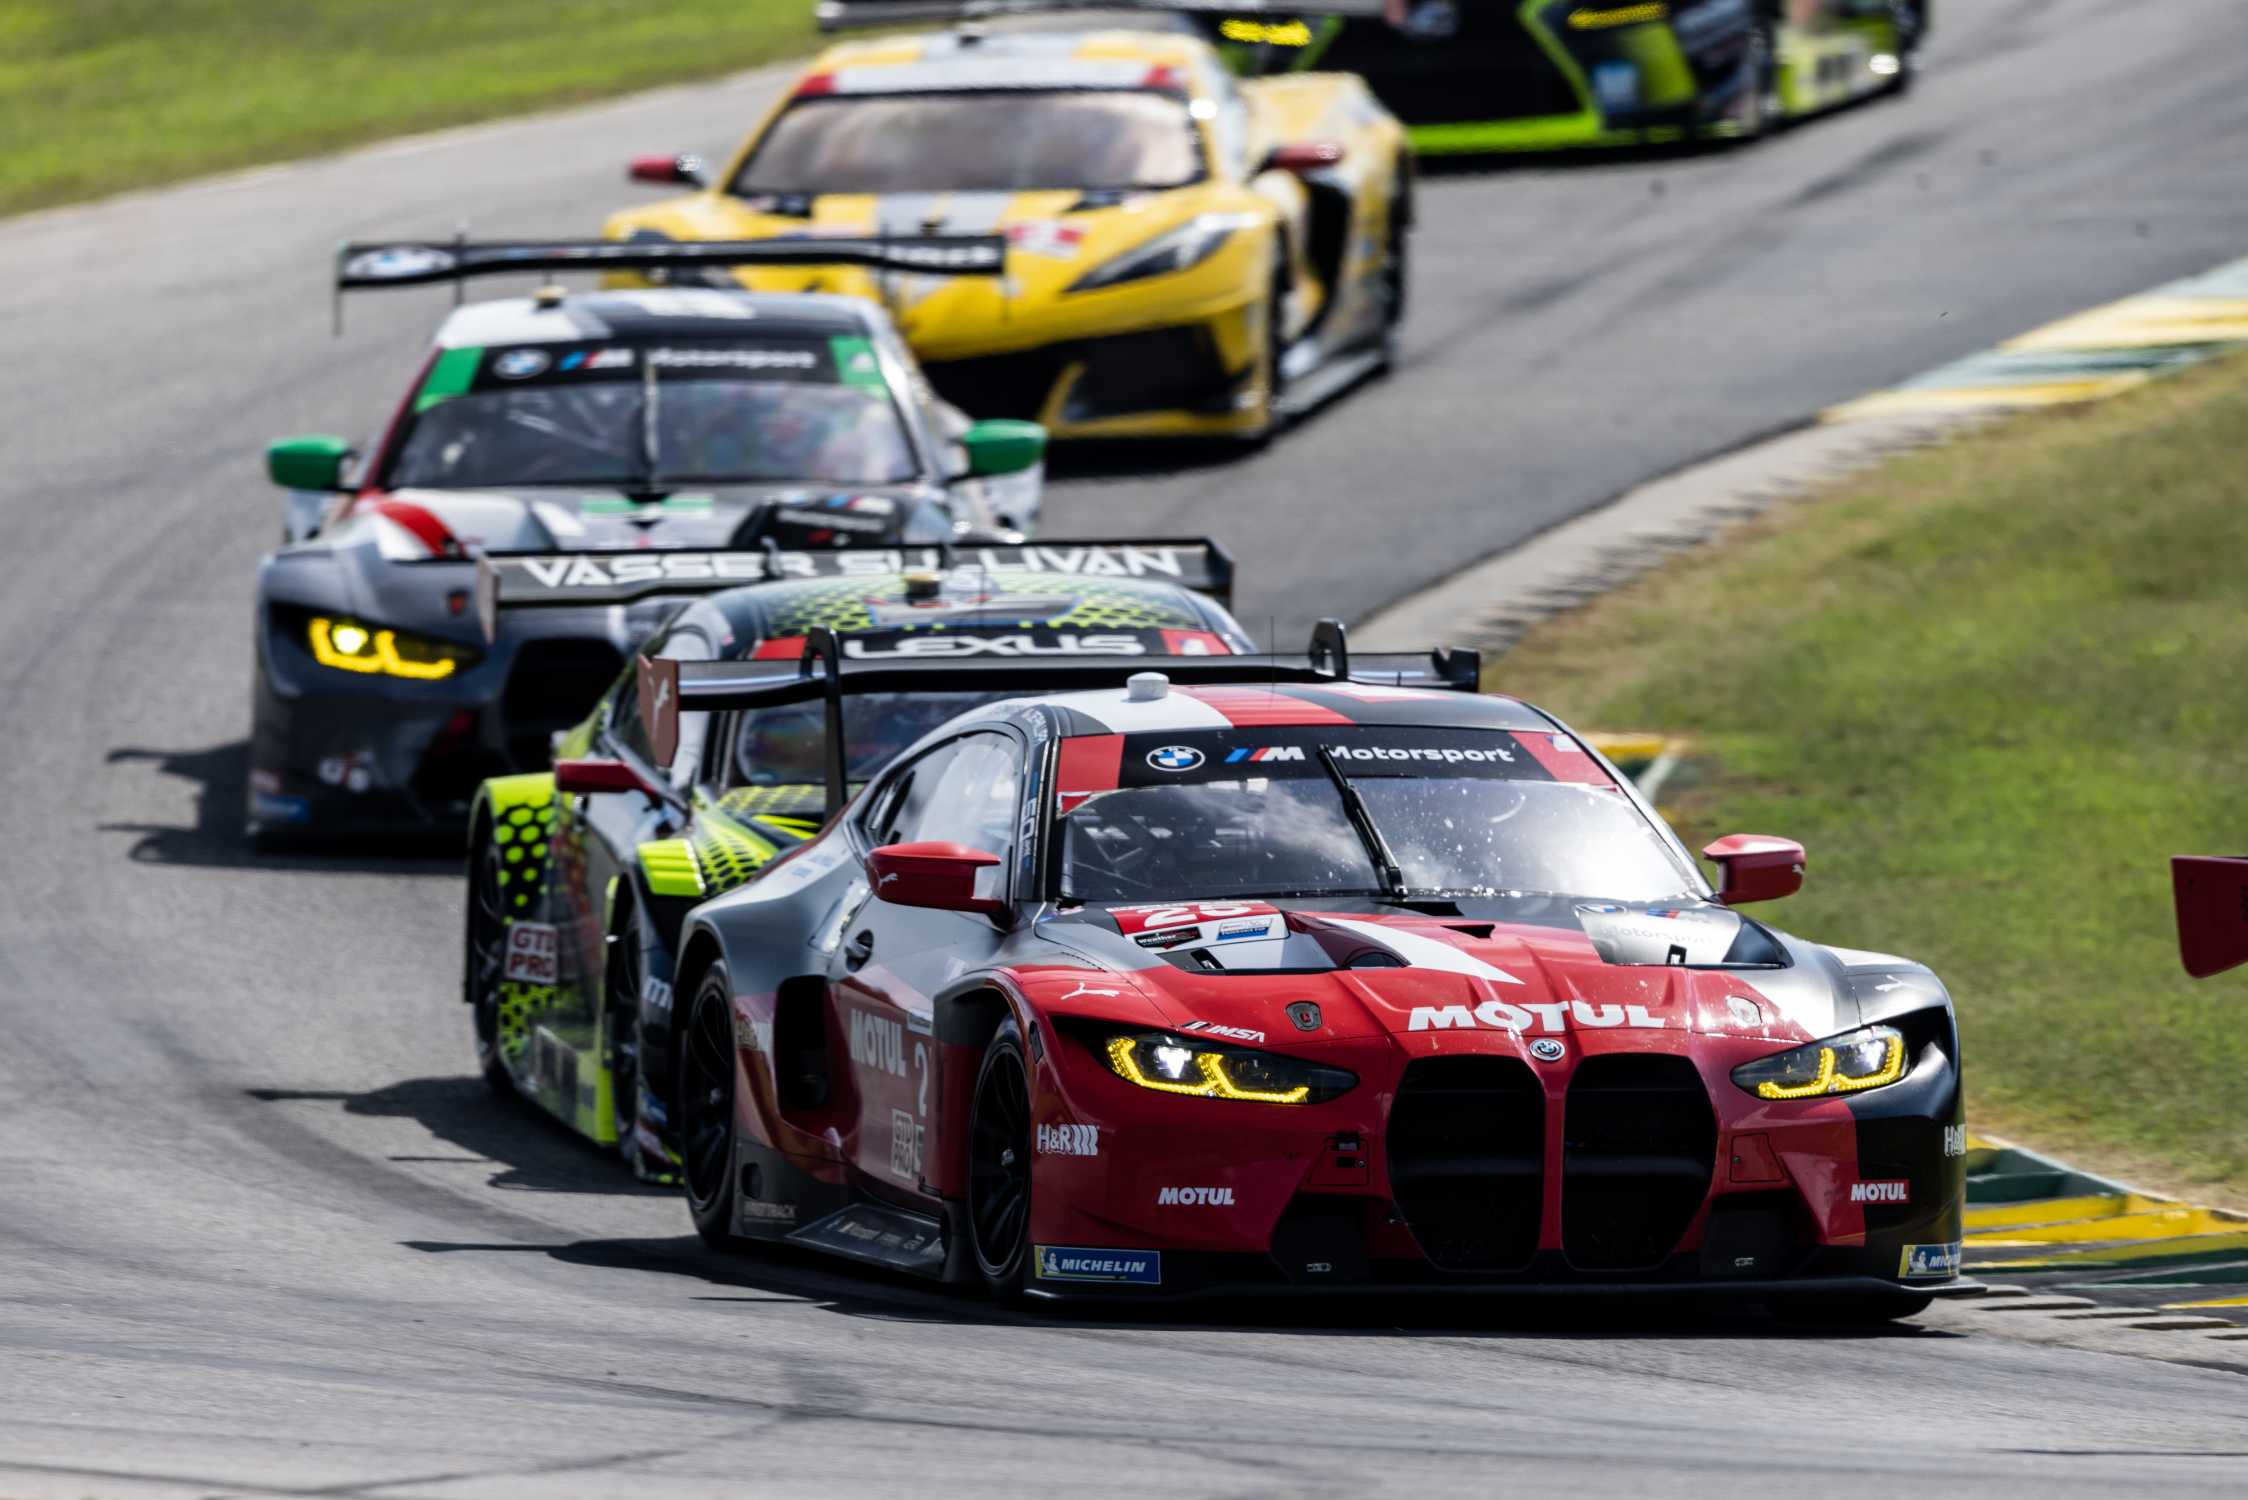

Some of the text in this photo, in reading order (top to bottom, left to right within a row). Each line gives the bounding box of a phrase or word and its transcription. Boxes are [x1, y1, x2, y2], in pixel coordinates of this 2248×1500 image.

[521, 548, 1182, 586] VASSER SULIVAN
[843, 633, 1146, 659] LEXUS
[1321, 744, 1515, 764] Motorsport
[1408, 999, 1666, 1032] MOTUL
[851, 1007, 907, 1078] MOTUL
[1205, 1024, 1266, 1043] IMSA
[1157, 1187, 1236, 1206] MOTUL
[1850, 1183, 1908, 1201] MOTUL
[1060, 1258, 1147, 1273] MICHELIN
